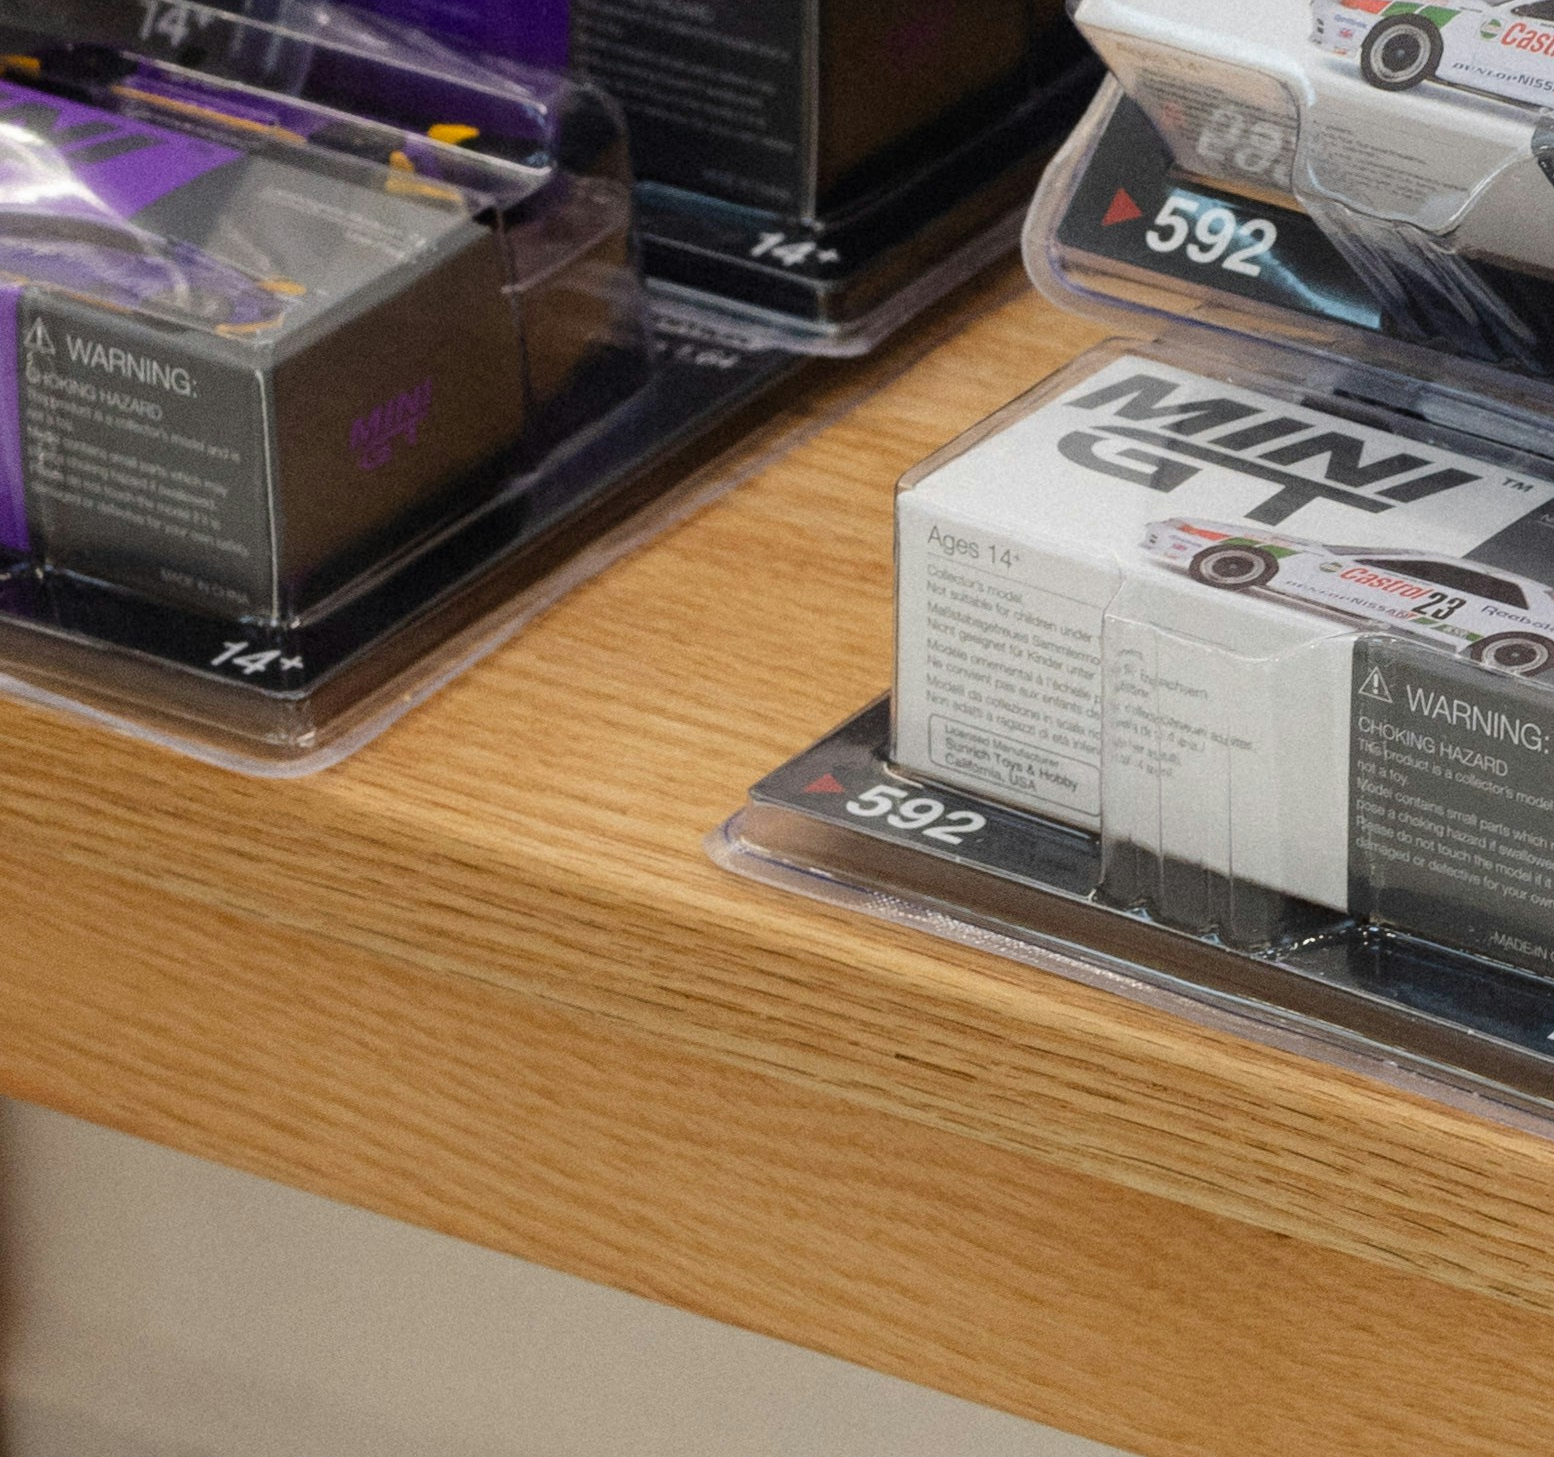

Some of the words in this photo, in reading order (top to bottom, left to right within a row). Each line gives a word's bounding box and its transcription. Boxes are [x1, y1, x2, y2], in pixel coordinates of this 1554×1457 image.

[1146, 195, 1277, 277] 592
[66, 335, 197, 399] WARNING:
[1061, 372, 1484, 504] MINI
[1057, 426, 1396, 527] GT
[927, 524, 980, 560] Ages
[988, 543, 1021, 569] 14+
[1339, 564, 1433, 600] Castrol
[1352, 595, 1413, 621] NISSAN
[1411, 591, 1468, 622] 23
[210, 641, 304, 675] 14+
[1358, 715, 1435, 753] CHOKING
[1440, 741, 1509, 777] HAZARD
[1406, 684, 1549, 754] WARNING:
[846, 785, 987, 845] 592
